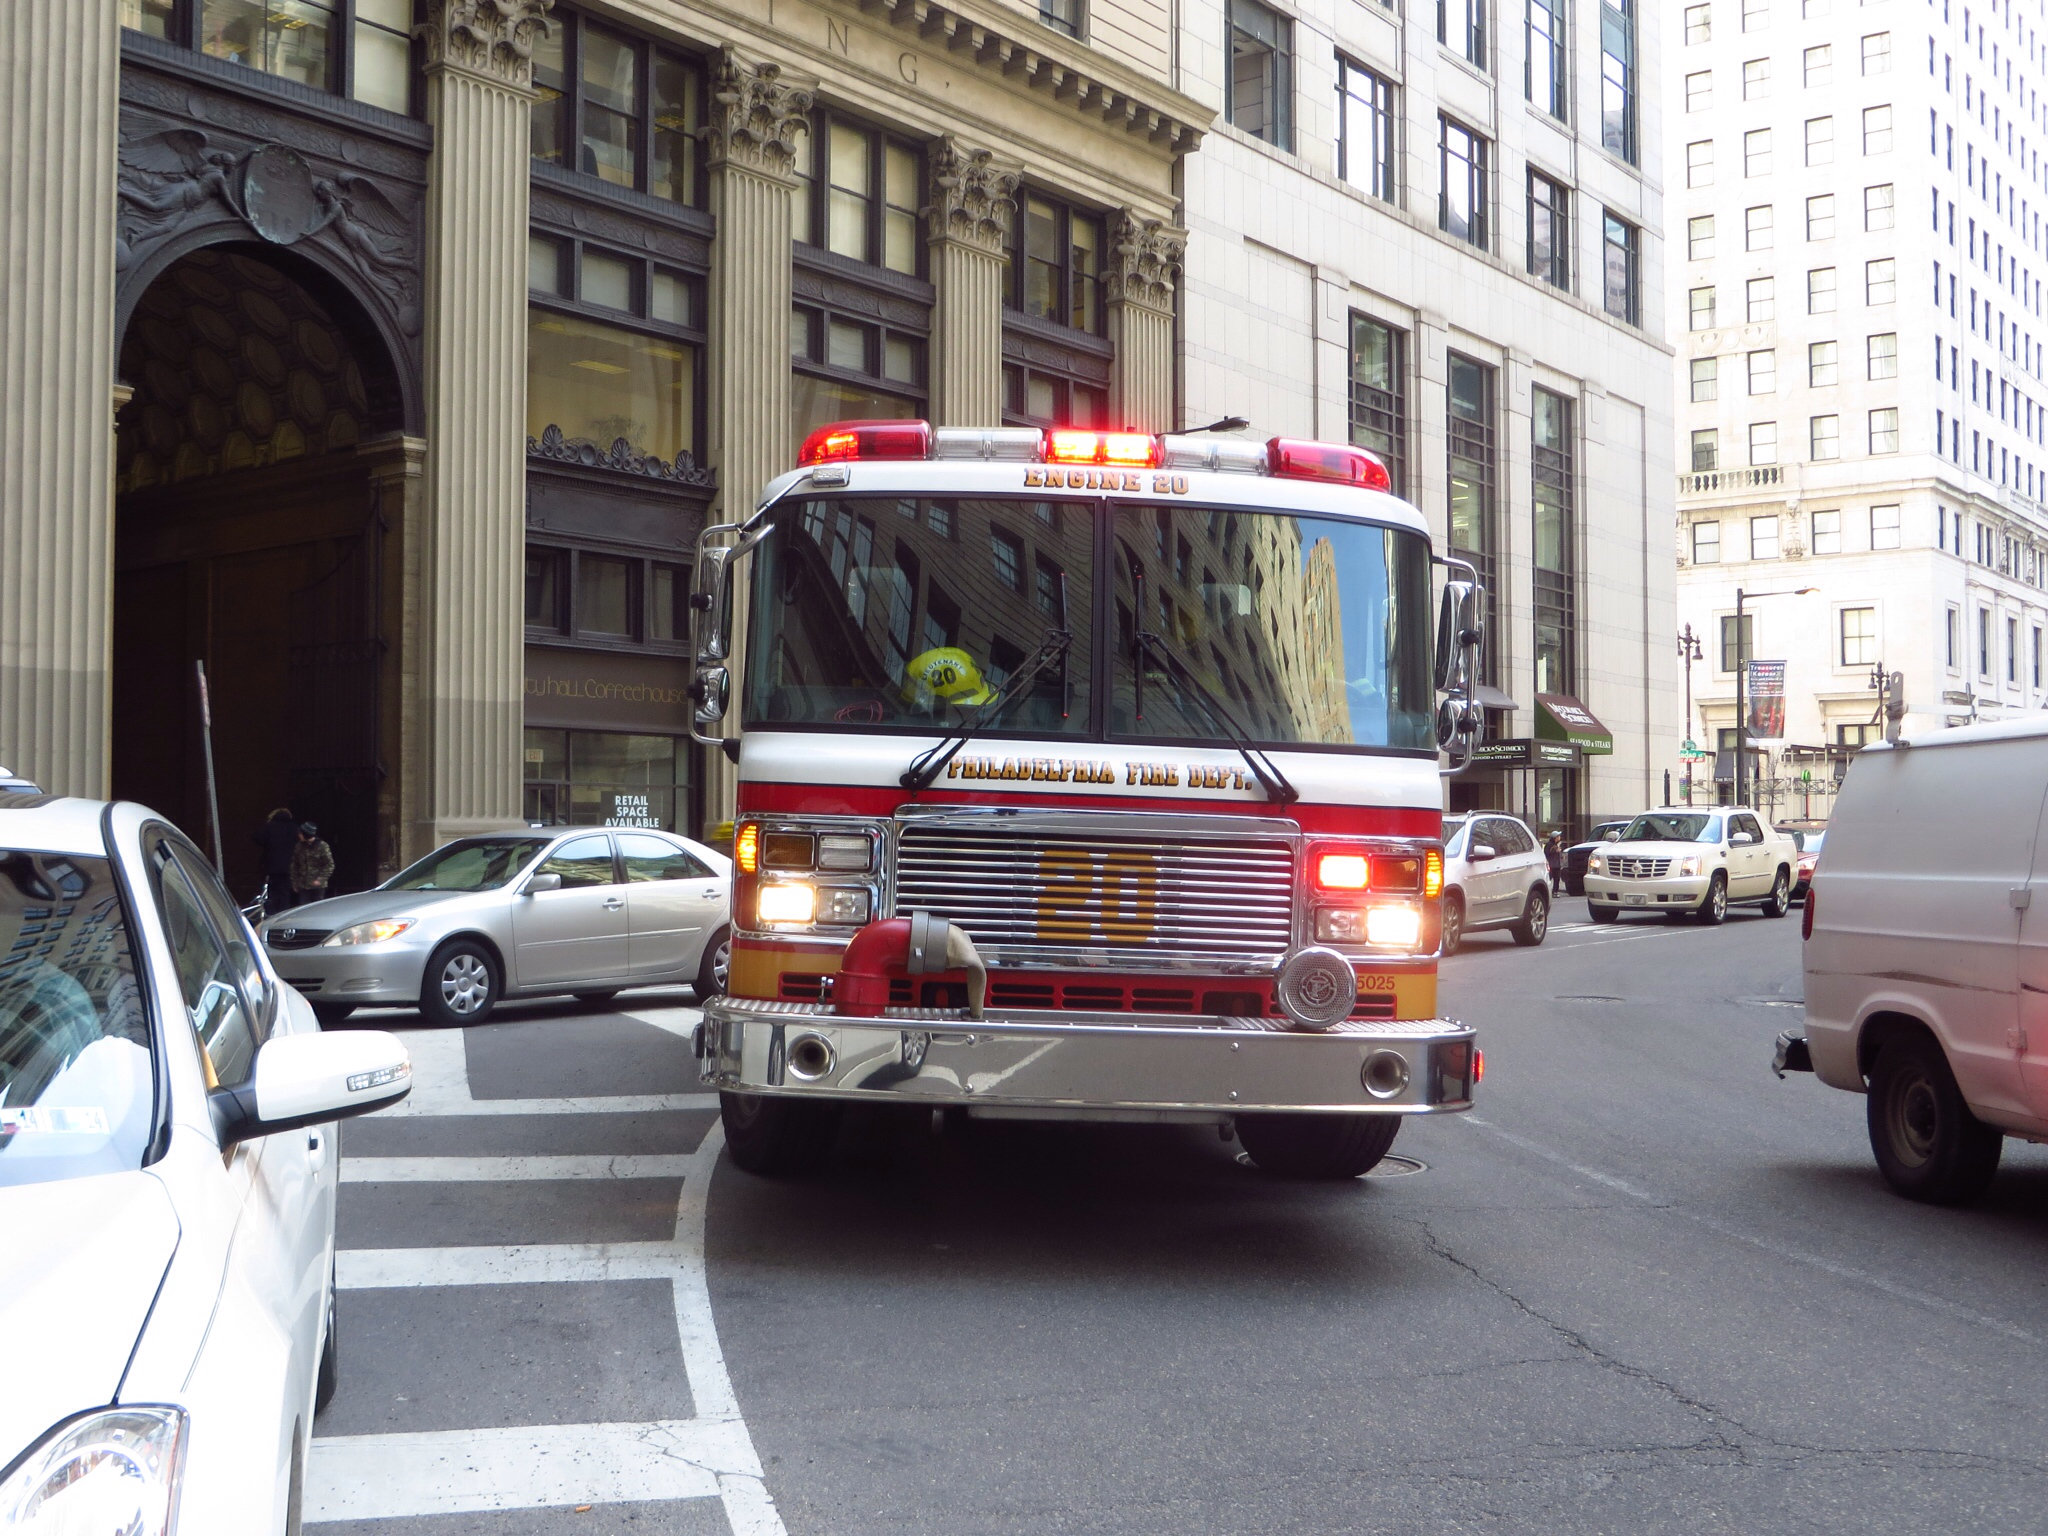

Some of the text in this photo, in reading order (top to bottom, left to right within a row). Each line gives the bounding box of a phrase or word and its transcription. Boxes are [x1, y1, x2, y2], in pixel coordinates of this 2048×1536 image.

[1024, 467, 1189, 495] ENGINE 20
[931, 667, 957, 688] 20
[585, 679, 687, 704] Coffeehouse
[1595, 741, 1611, 749] STEAKS
[948, 755, 1253, 790] PHILADELPHIA FIRE DEPT.
[615, 795, 649, 806] RETAIL
[616, 806, 648, 817] SPACE
[604, 817, 660, 828] AVAILABLE
[1036, 849, 1157, 943] 20
[1356, 975, 1396, 991] 5025
